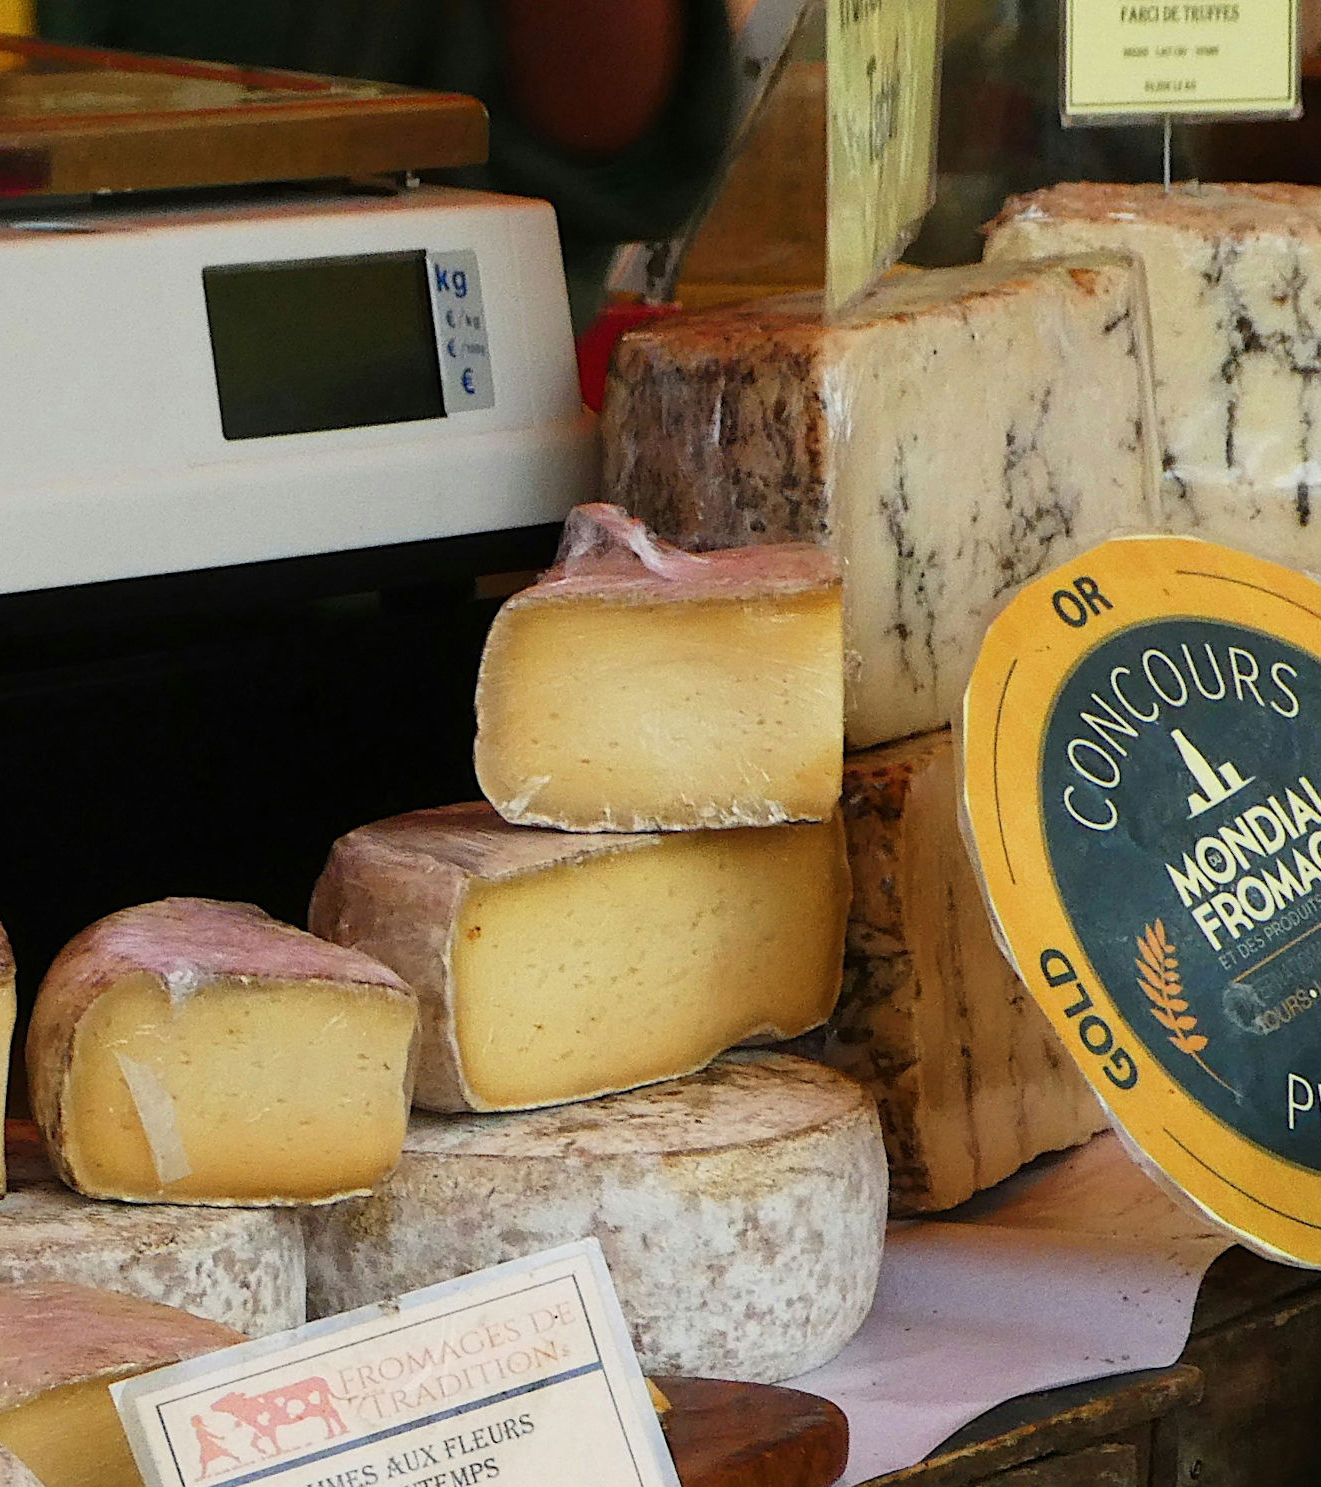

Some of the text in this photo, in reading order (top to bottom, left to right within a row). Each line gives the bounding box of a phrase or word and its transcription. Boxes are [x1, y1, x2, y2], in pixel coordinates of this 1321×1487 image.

[434, 263, 468, 298] kg
[460, 367, 476, 395] €
[1051, 574, 1114, 630] OR
[1062, 642, 1302, 834] CONCOURS
[1218, 950, 1239, 971] ET
[1237, 935, 1266, 959] DES
[1038, 947, 1139, 1091] GOLD
[337, 1300, 577, 1396] FROMAGES DE
[387, 1443, 441, 1480] AUX
[443, 1413, 536, 1459] FLEURS
